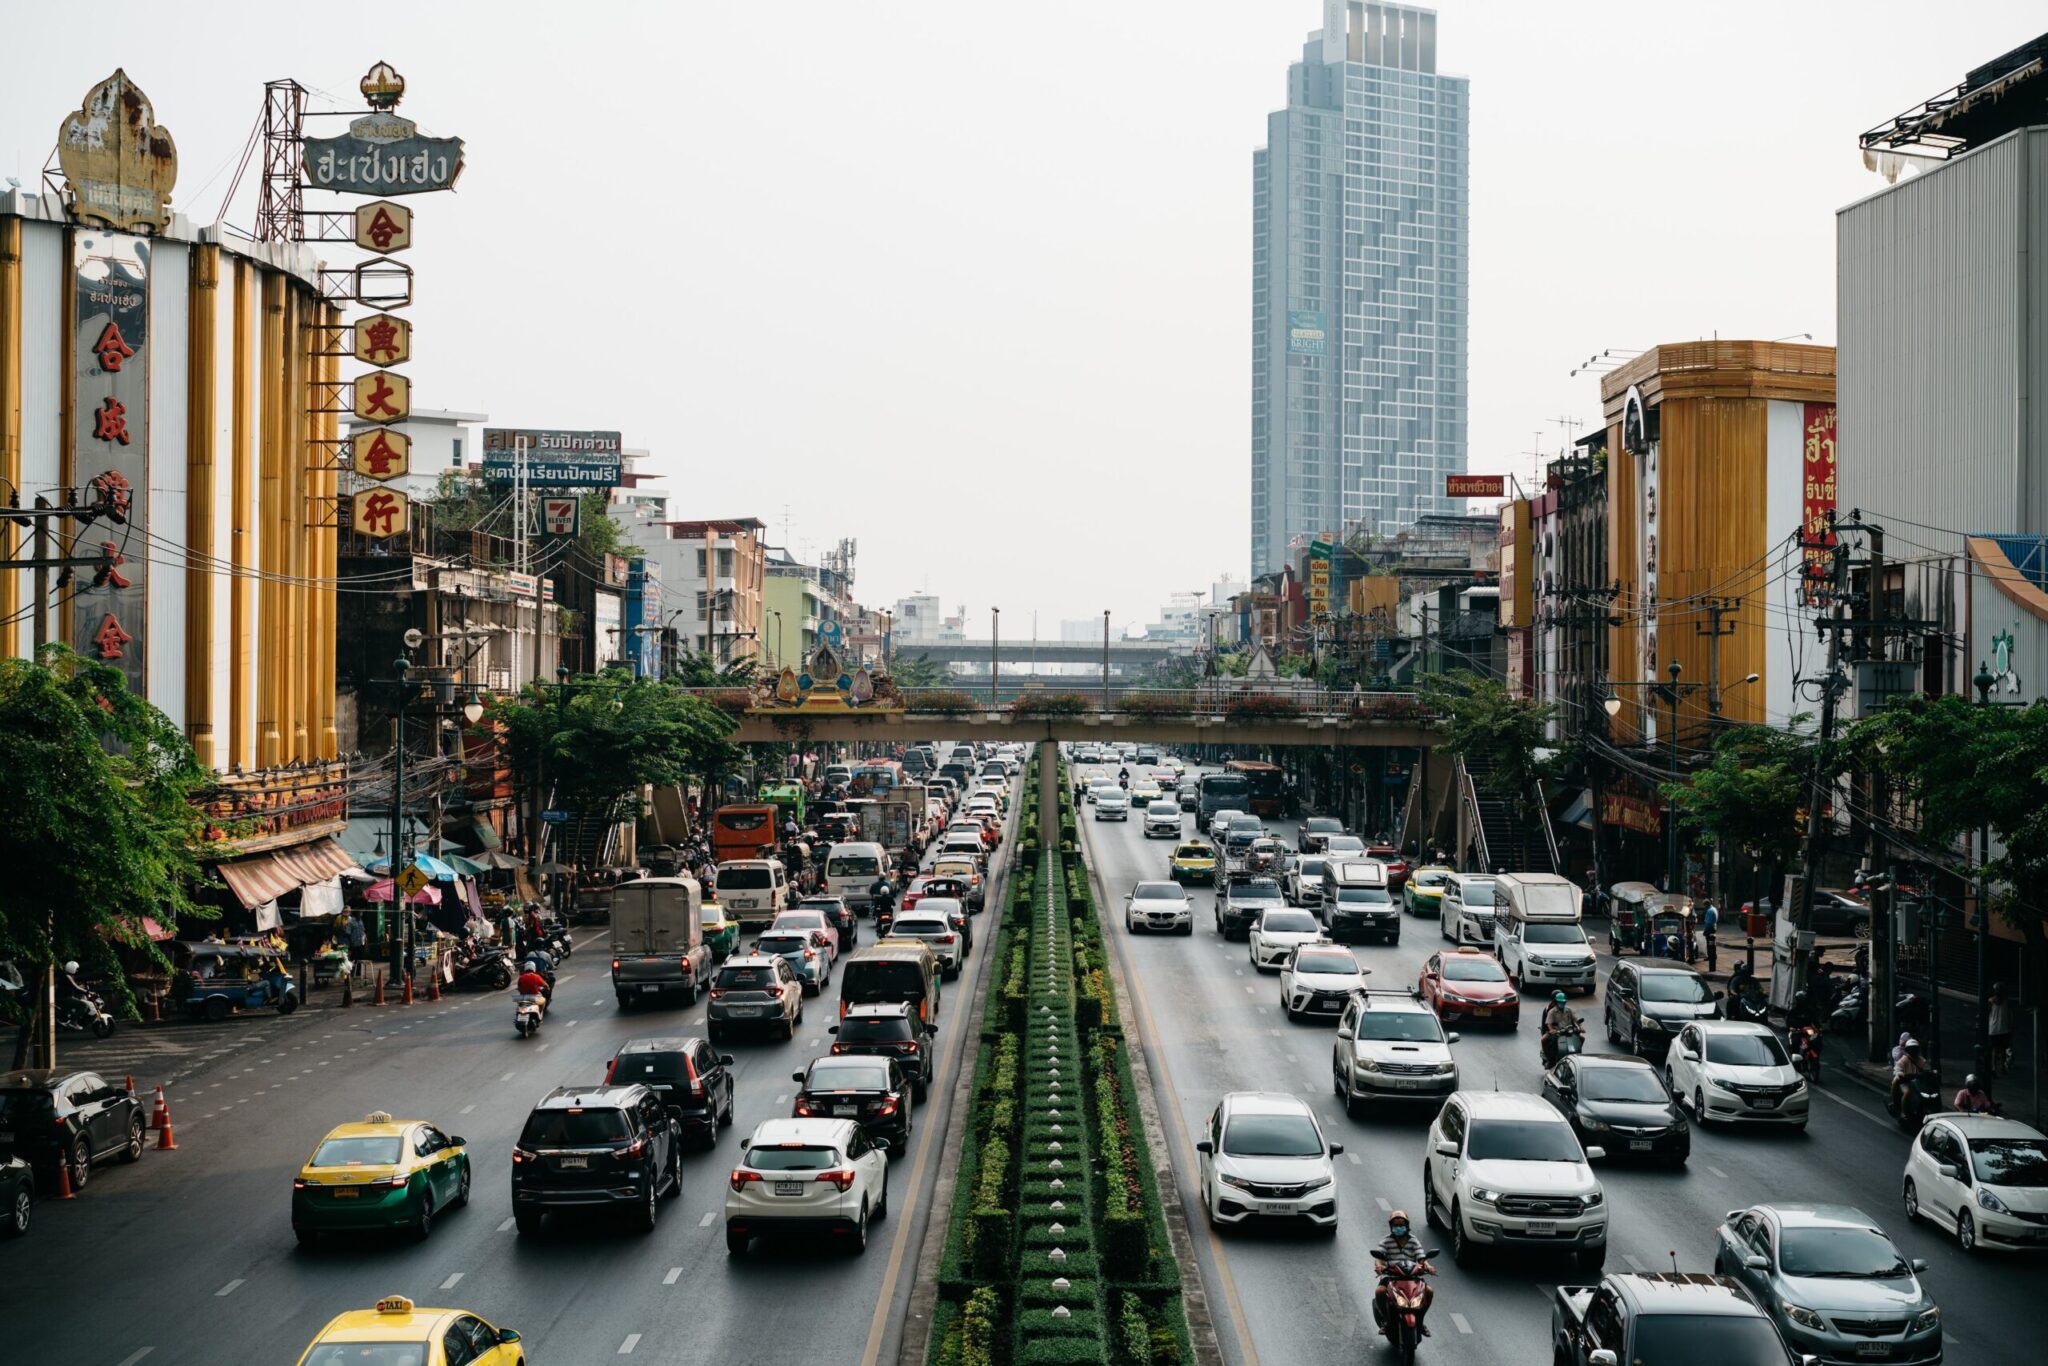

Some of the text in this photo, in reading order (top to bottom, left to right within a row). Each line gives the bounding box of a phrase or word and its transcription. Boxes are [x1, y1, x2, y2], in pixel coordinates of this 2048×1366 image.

[317, 144, 448, 184] ฮะเซ่งเฮง
[540, 433, 617, 450] รับปักด่วน
[549, 503, 571, 532] 7
[385, 1301, 402, 1310] TAXI
